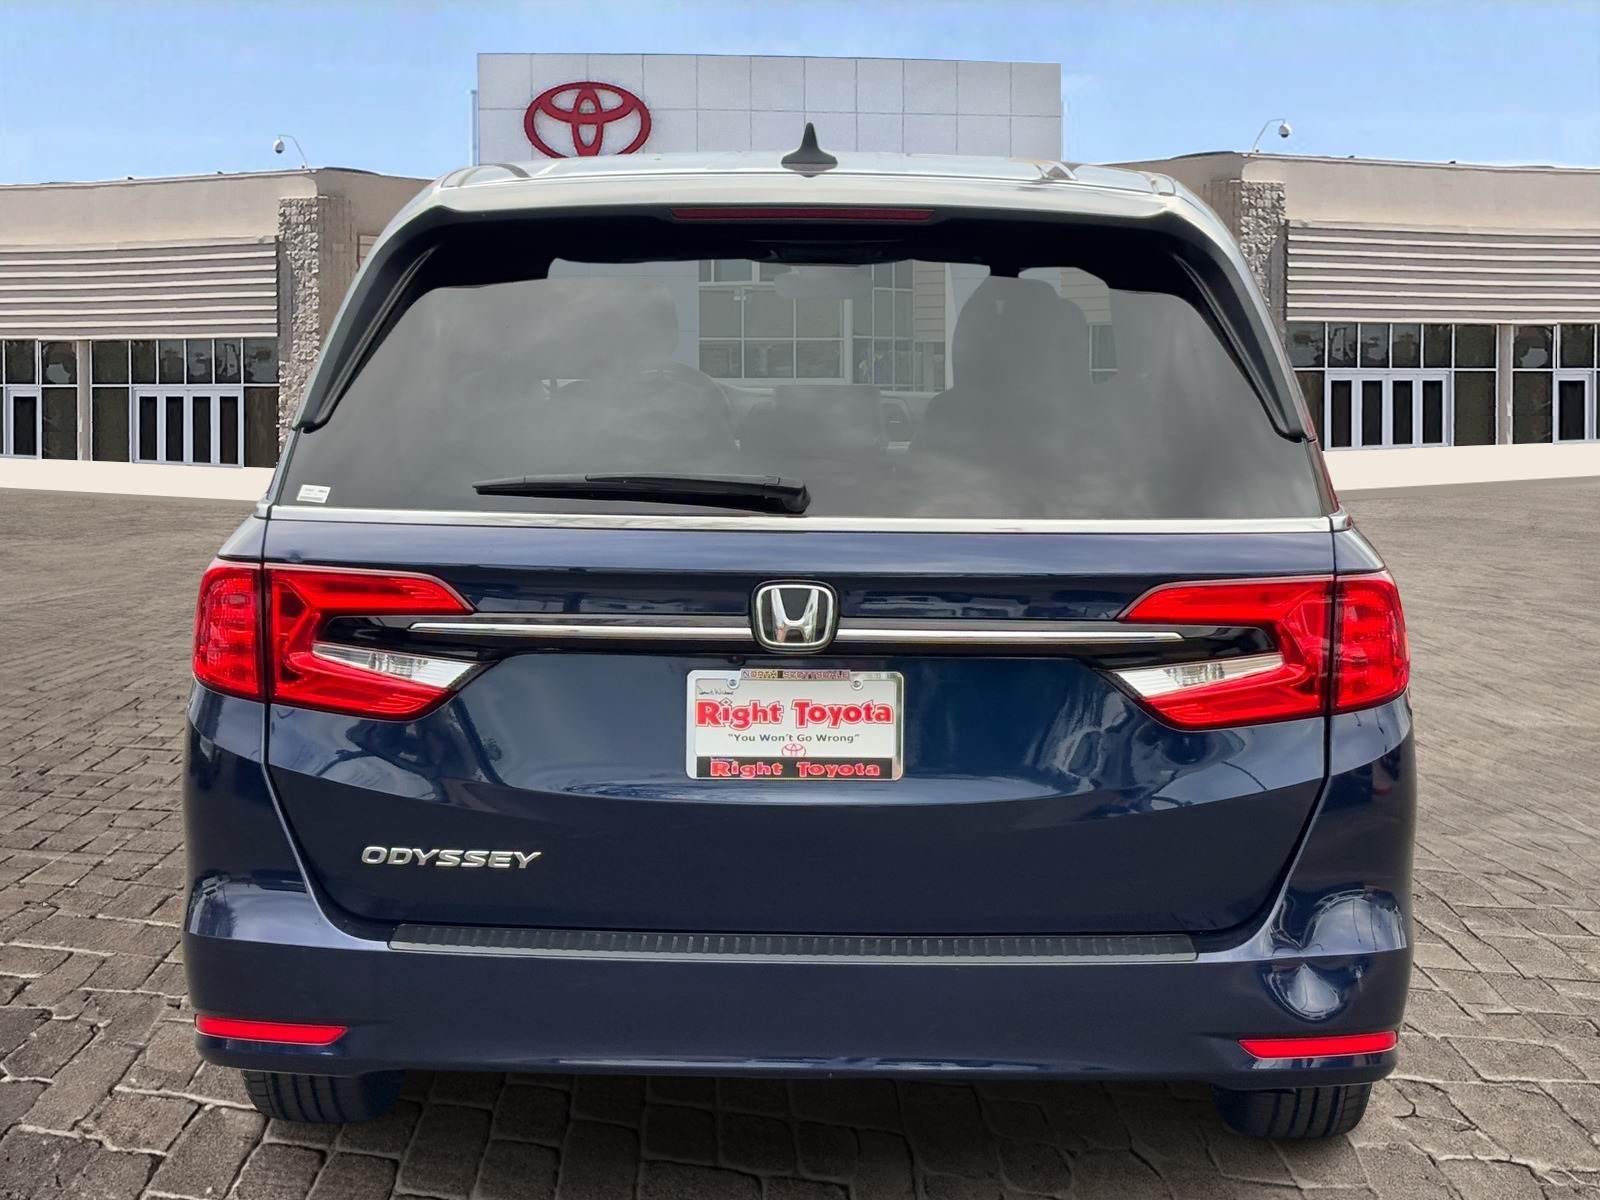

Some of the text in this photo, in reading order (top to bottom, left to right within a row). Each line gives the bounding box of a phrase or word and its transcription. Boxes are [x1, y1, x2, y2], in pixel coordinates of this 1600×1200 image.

[695, 697, 894, 731] Right Toyota
[728, 733, 860, 743] "You Won't Go Wrong"
[710, 760, 880, 778] Right Toyota
[361, 845, 542, 869] ODYSSEY
